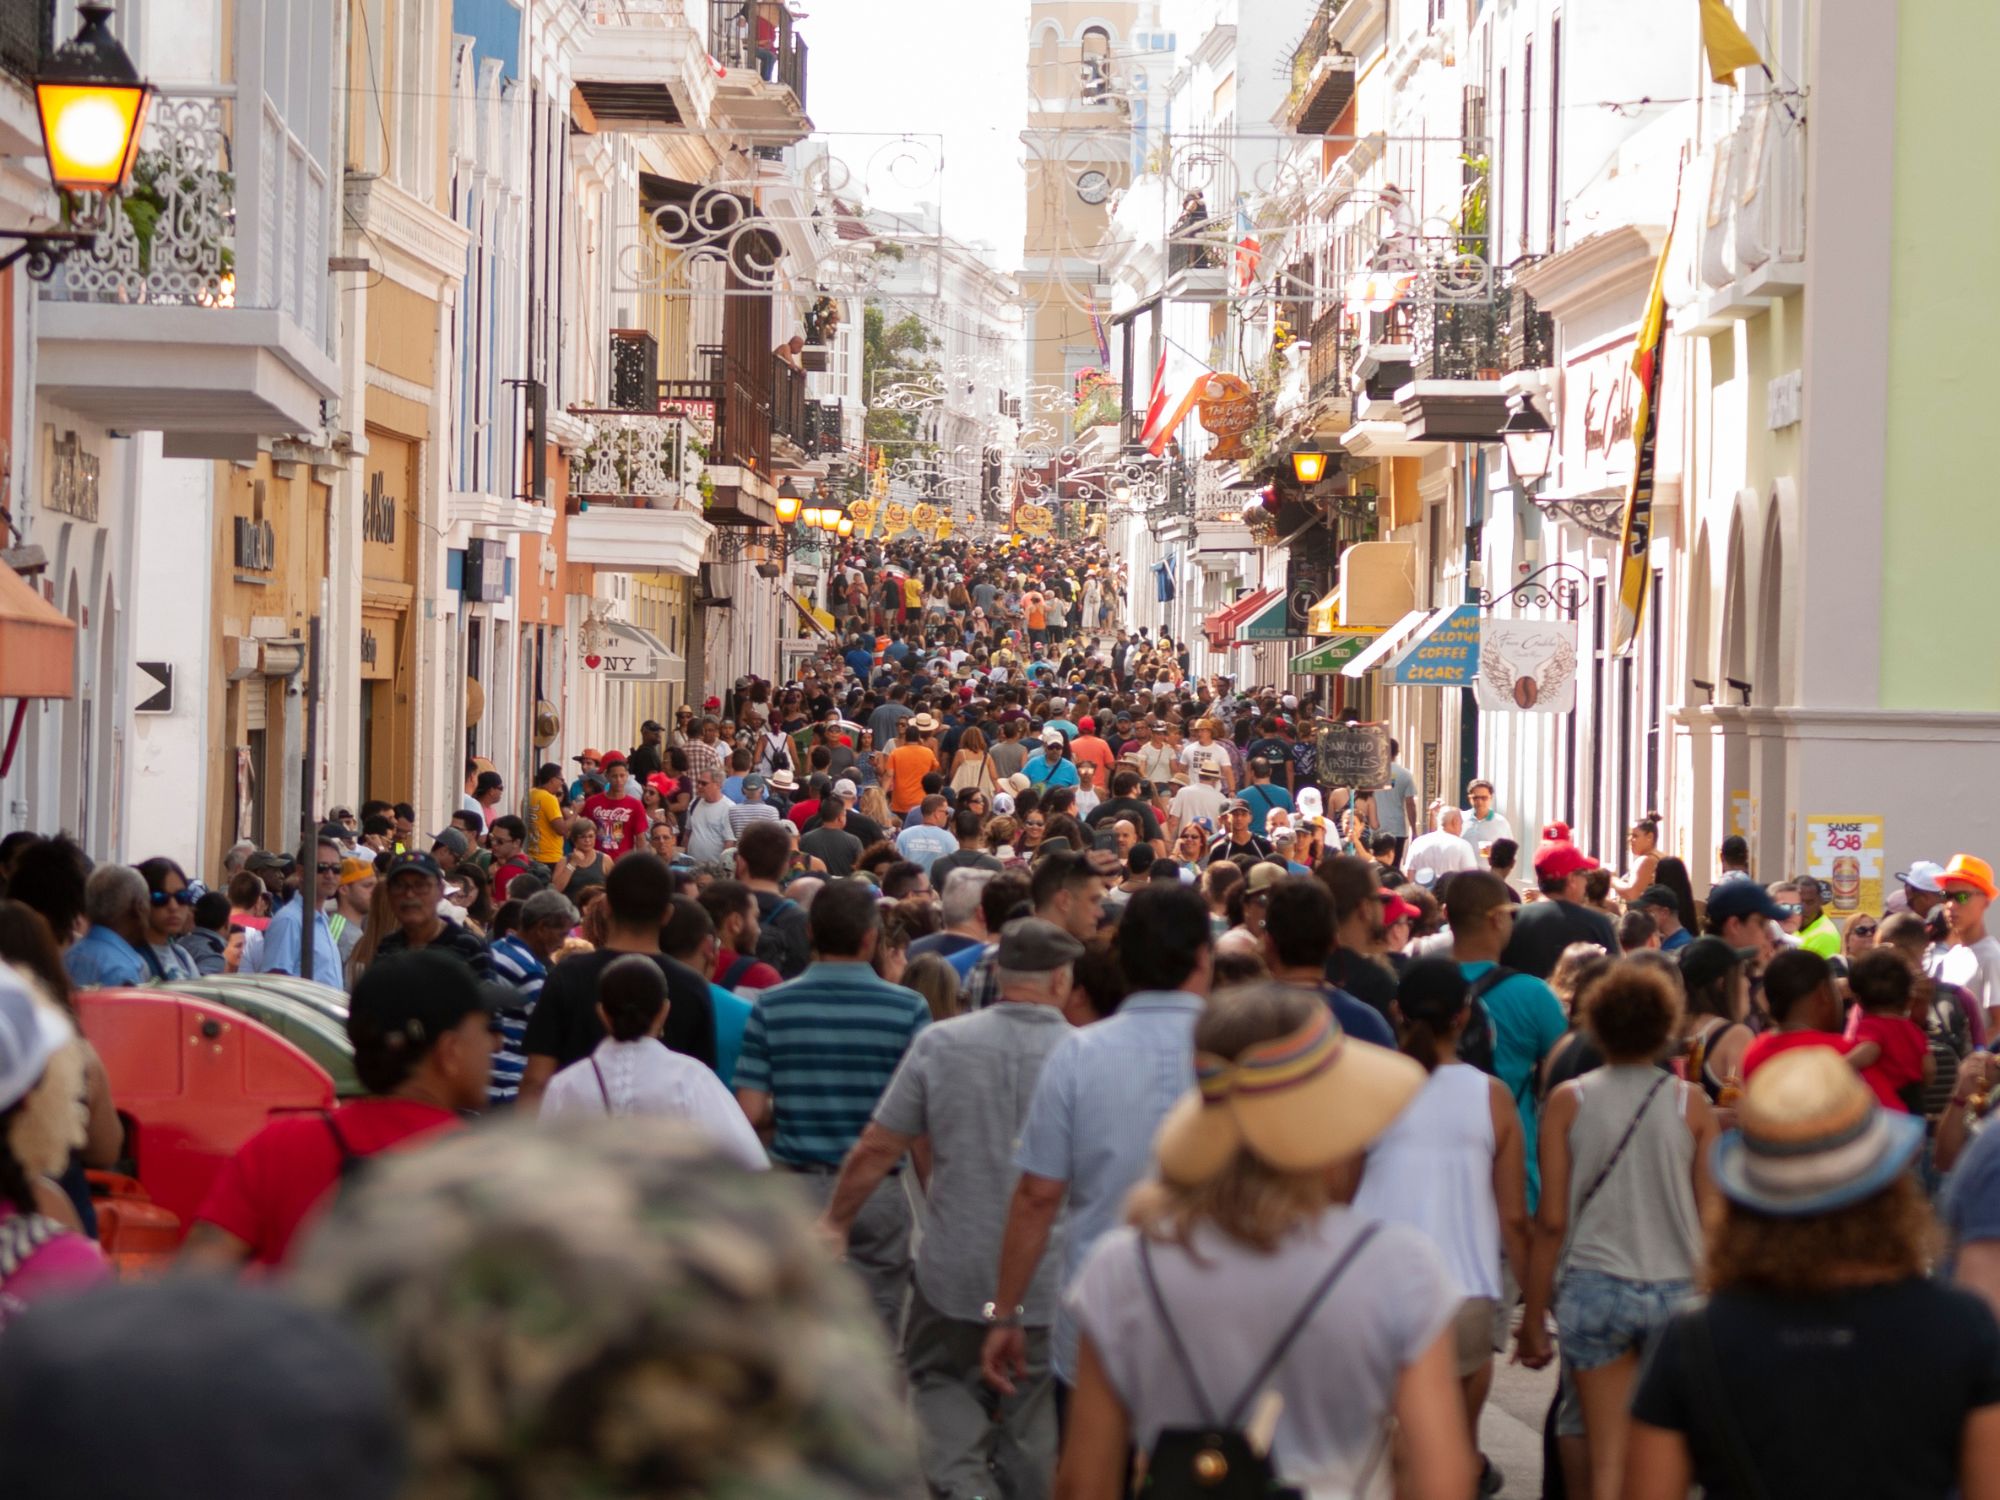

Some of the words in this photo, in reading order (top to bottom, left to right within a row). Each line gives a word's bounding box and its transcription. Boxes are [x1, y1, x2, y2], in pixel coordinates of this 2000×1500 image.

[660, 402, 682, 412] FOR
[685, 403, 713, 419] SALE
[1301, 594, 1312, 612] 7
[1418, 646, 1468, 659] COFFEE
[603, 656, 636, 671] NY
[1408, 666, 1464, 679] CIGARS
[1327, 741, 1374, 754] SANCOCHO
[1328, 756, 1380, 770] PASTELES
[1549, 828, 1558, 838] B
[1828, 823, 1862, 832] SANSE
[1828, 830, 1862, 851] 2018
